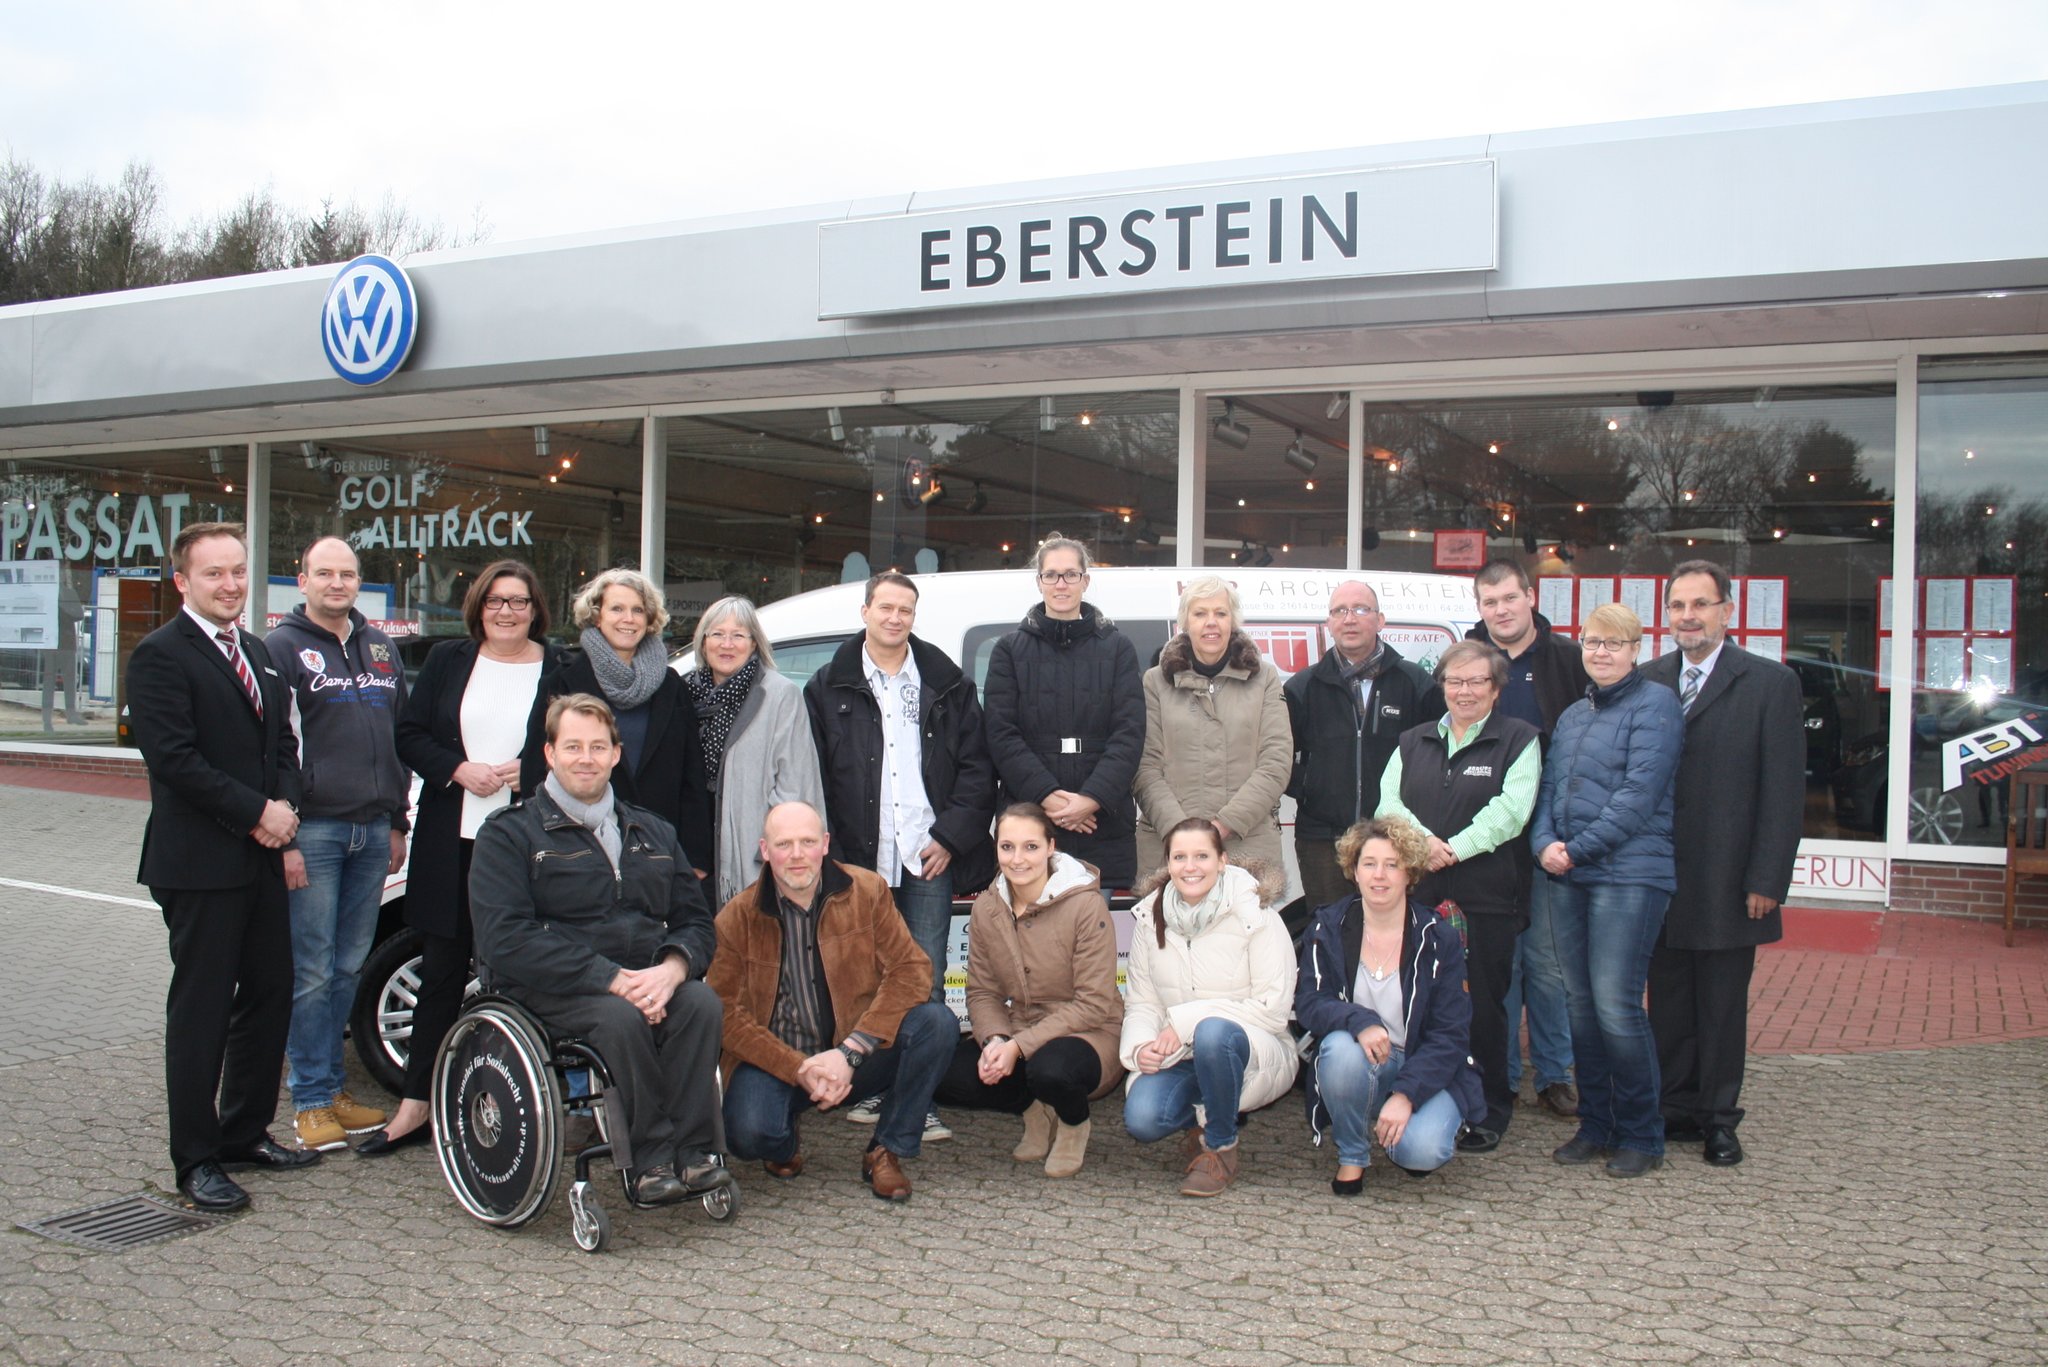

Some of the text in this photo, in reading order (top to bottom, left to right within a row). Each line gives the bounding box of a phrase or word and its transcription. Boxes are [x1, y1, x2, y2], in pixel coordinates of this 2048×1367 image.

[920, 190, 1359, 292] EBERSTEIN
[324, 262, 405, 376] VW
[334, 458, 390, 473] DER NEUE
[340, 469, 427, 511] GOLF
[1, 493, 190, 561] PASSAT
[364, 506, 533, 549] ALLTRACK
[1259, 580, 1477, 599] ARCHEKTEN
[376, 620, 419, 634] Zukunft!
[310, 672, 398, 692] Camp David
[1942, 717, 2043, 793] ABT
[457, 1061, 474, 1104] Kanzlei
[473, 1055, 486, 1069] für
[486, 1053, 523, 1103] Sozialrecht
